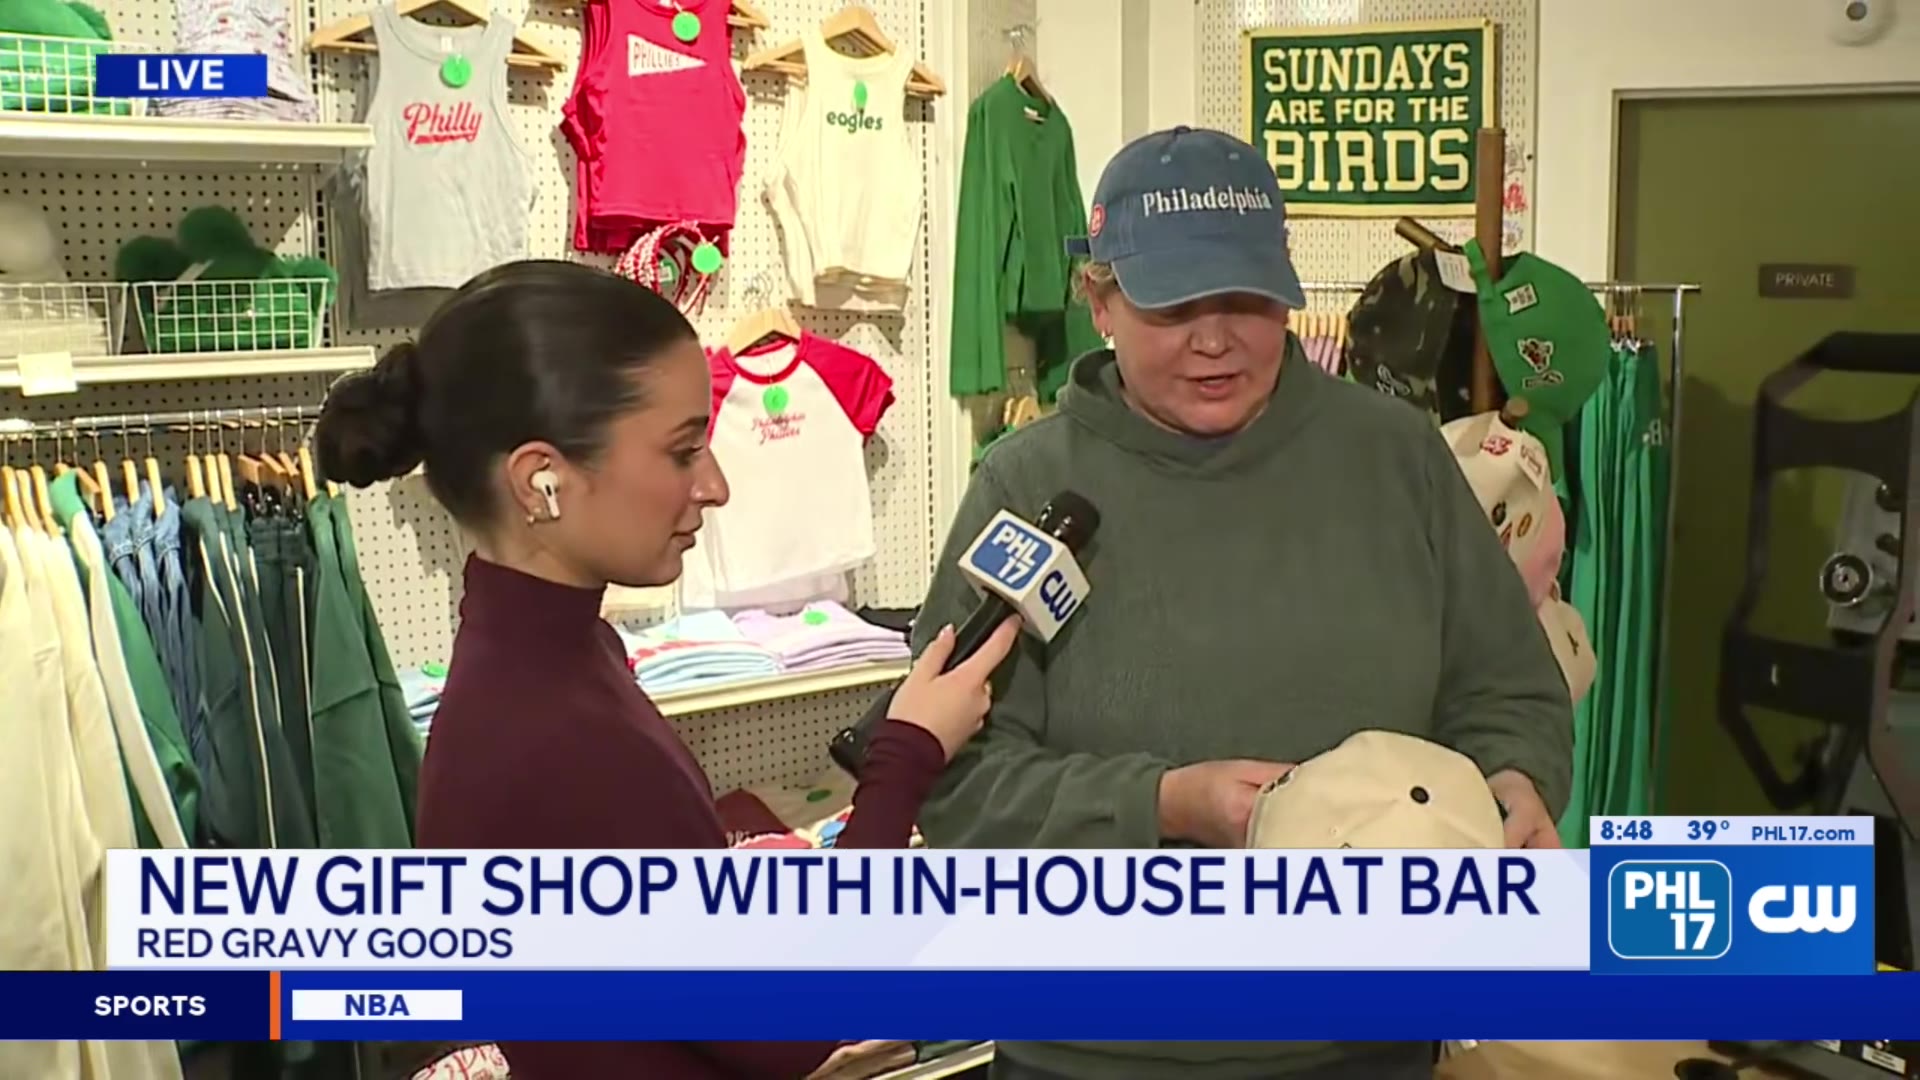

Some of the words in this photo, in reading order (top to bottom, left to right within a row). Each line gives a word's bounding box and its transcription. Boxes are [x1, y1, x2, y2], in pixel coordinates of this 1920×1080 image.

[633, 41, 680, 70] PHILLIES
[1263, 43, 1470, 93] SUNDAYS
[403, 101, 482, 144] Philly
[826, 109, 883, 134] eagles
[1265, 99, 1325, 124] ARE
[1335, 98, 1395, 124] FOR
[1408, 96, 1470, 123] THE
[1263, 128, 1470, 192] BIRDS
[1142, 184, 1273, 218] Philadelphia
[1775, 271, 1834, 288] PRIVATE
[991, 524, 1041, 568] PHL
[997, 556, 1033, 585] 17
[1039, 569, 1078, 623] CW
